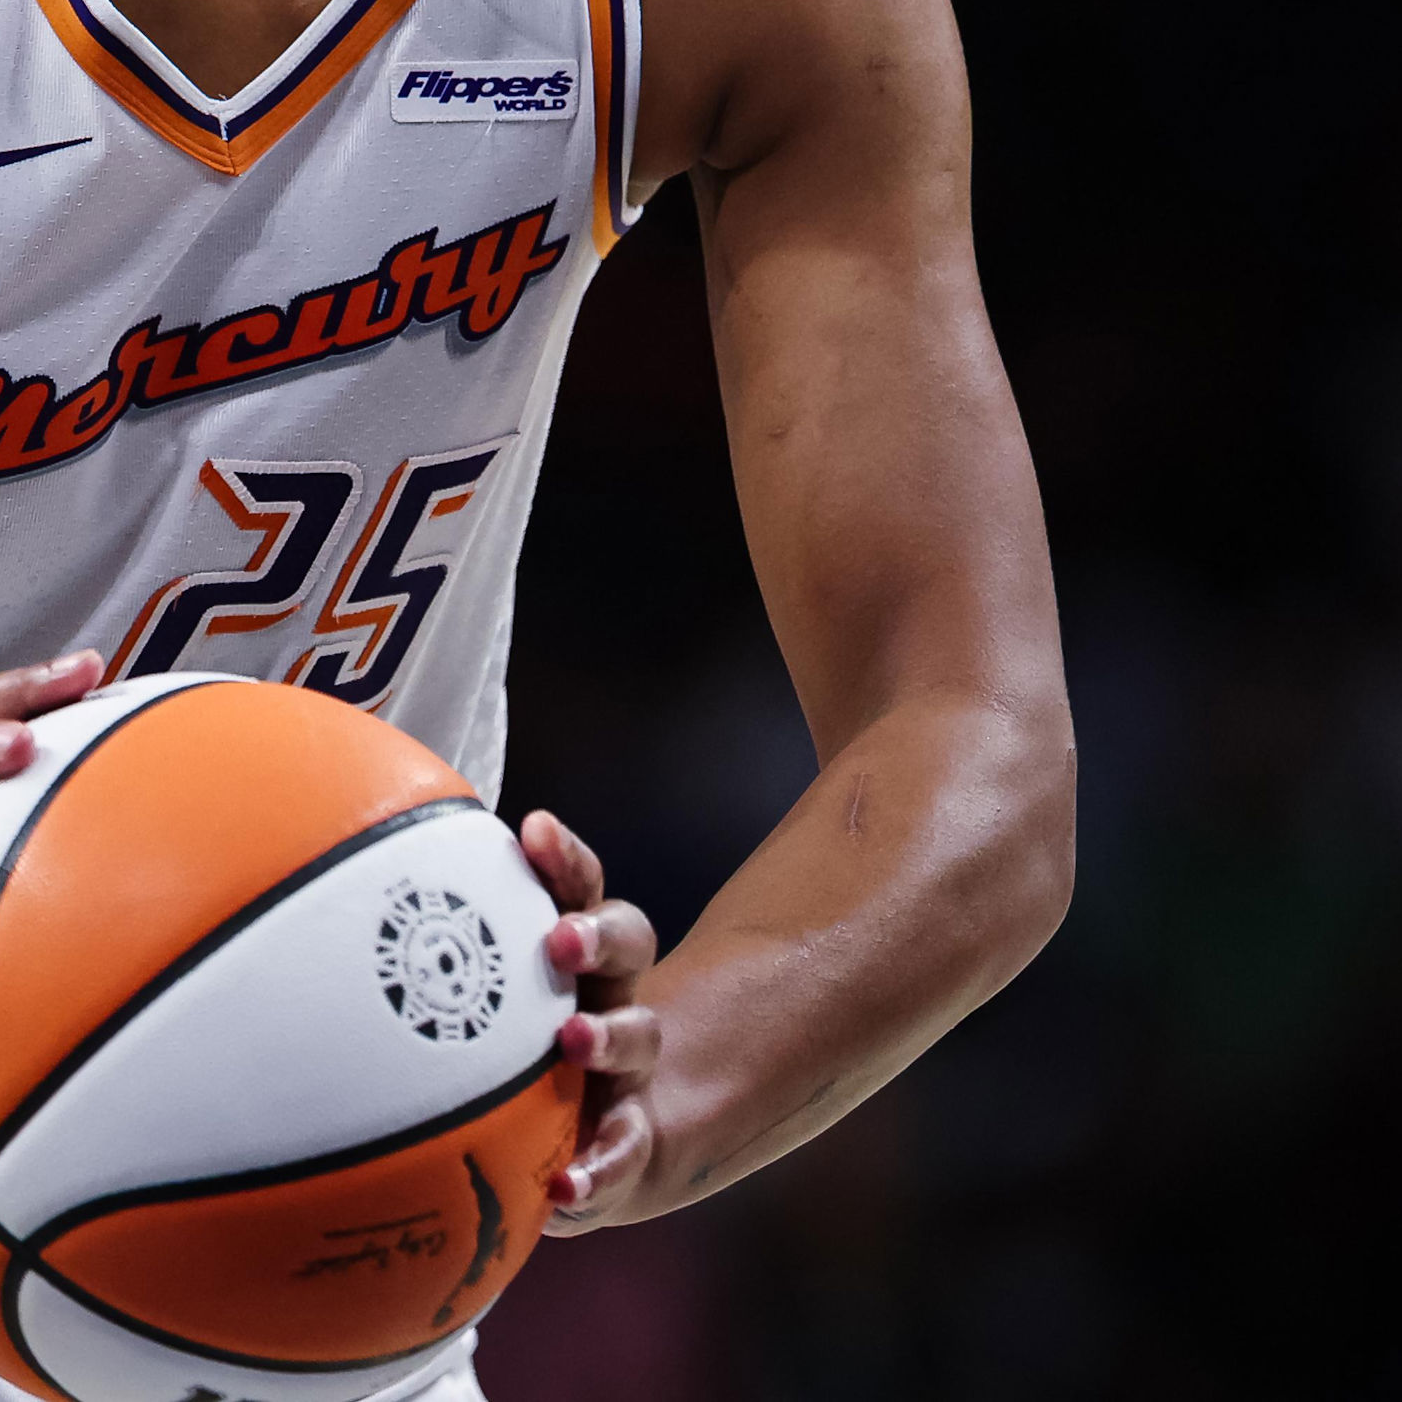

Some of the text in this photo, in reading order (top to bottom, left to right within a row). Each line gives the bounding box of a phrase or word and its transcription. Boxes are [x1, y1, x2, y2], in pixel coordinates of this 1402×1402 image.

[397, 71, 573, 104] Flipper's
[494, 99, 566, 111] WORLD
[101, 434, 518, 712] 25
